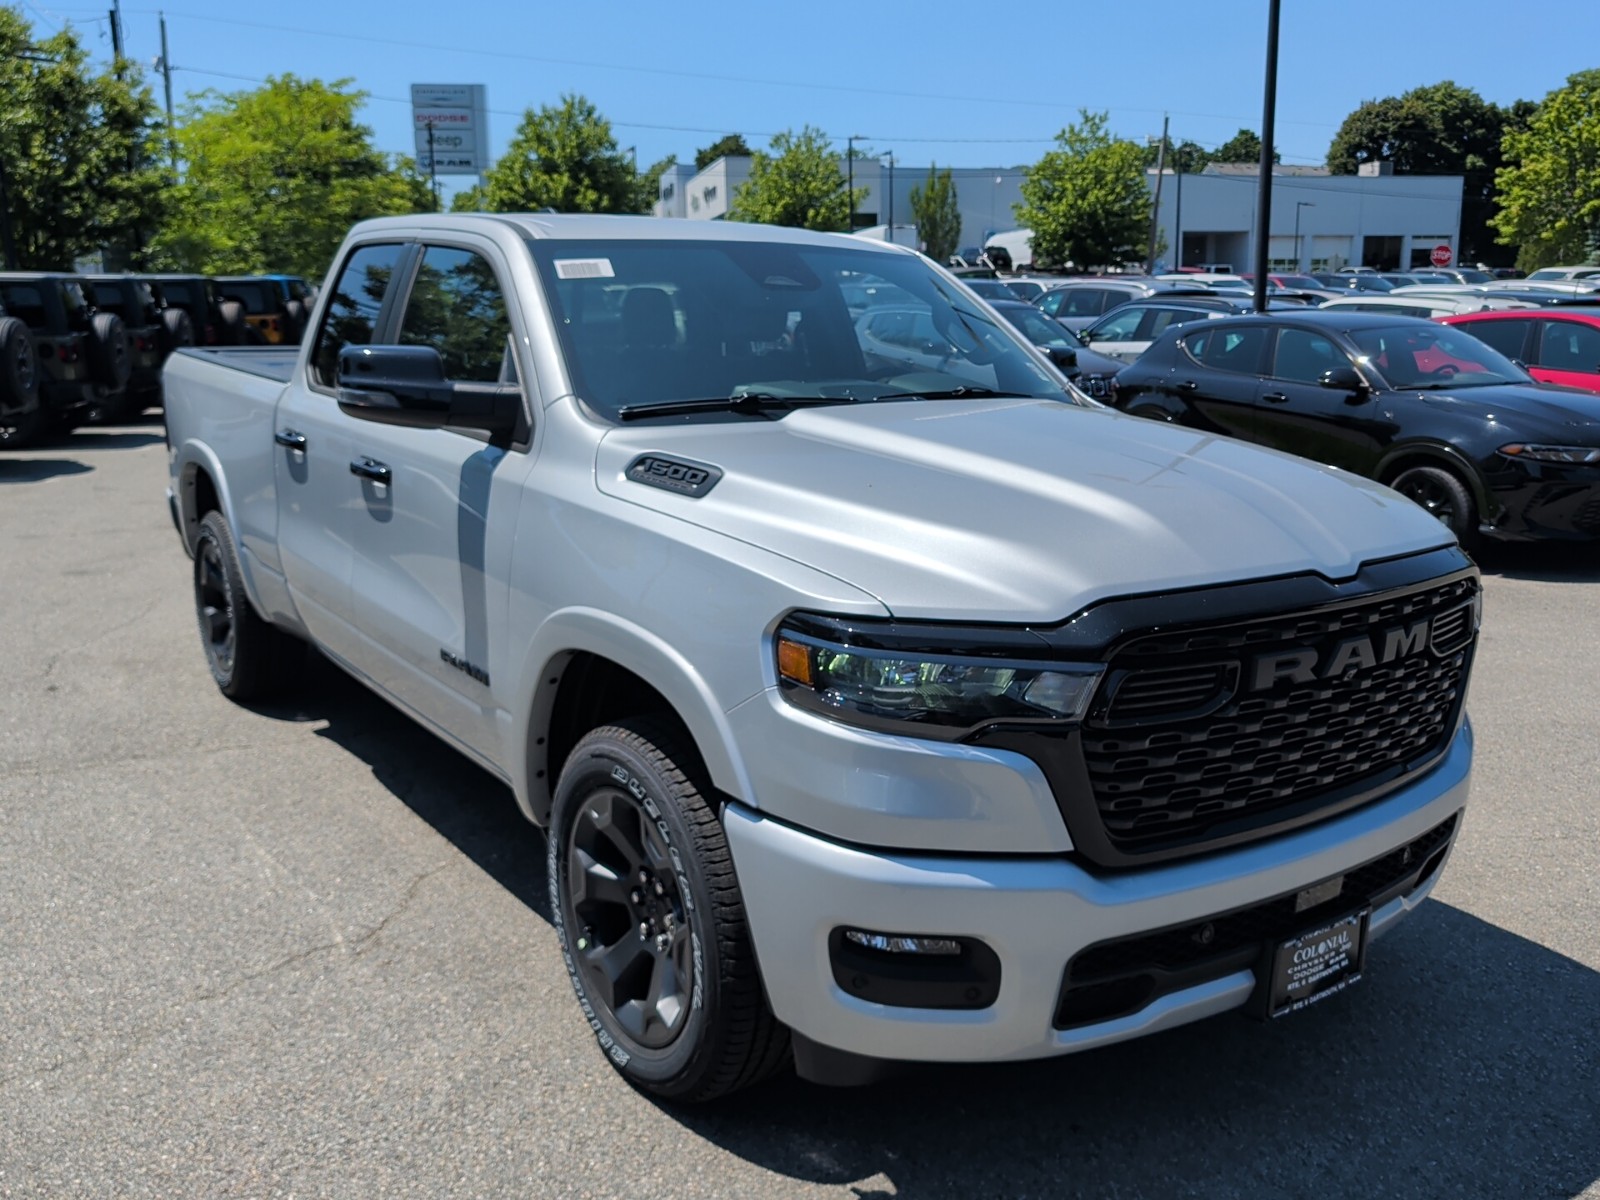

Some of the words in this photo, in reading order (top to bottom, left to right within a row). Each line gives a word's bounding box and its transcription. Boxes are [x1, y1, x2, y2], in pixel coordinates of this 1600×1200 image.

[643, 459, 708, 485] 1500
[1254, 620, 1429, 690] RAM
[1293, 930, 1350, 964] COLONIAL
[1287, 951, 1336, 974] CHRYSLER
[1293, 963, 1325, 980] DODGE
